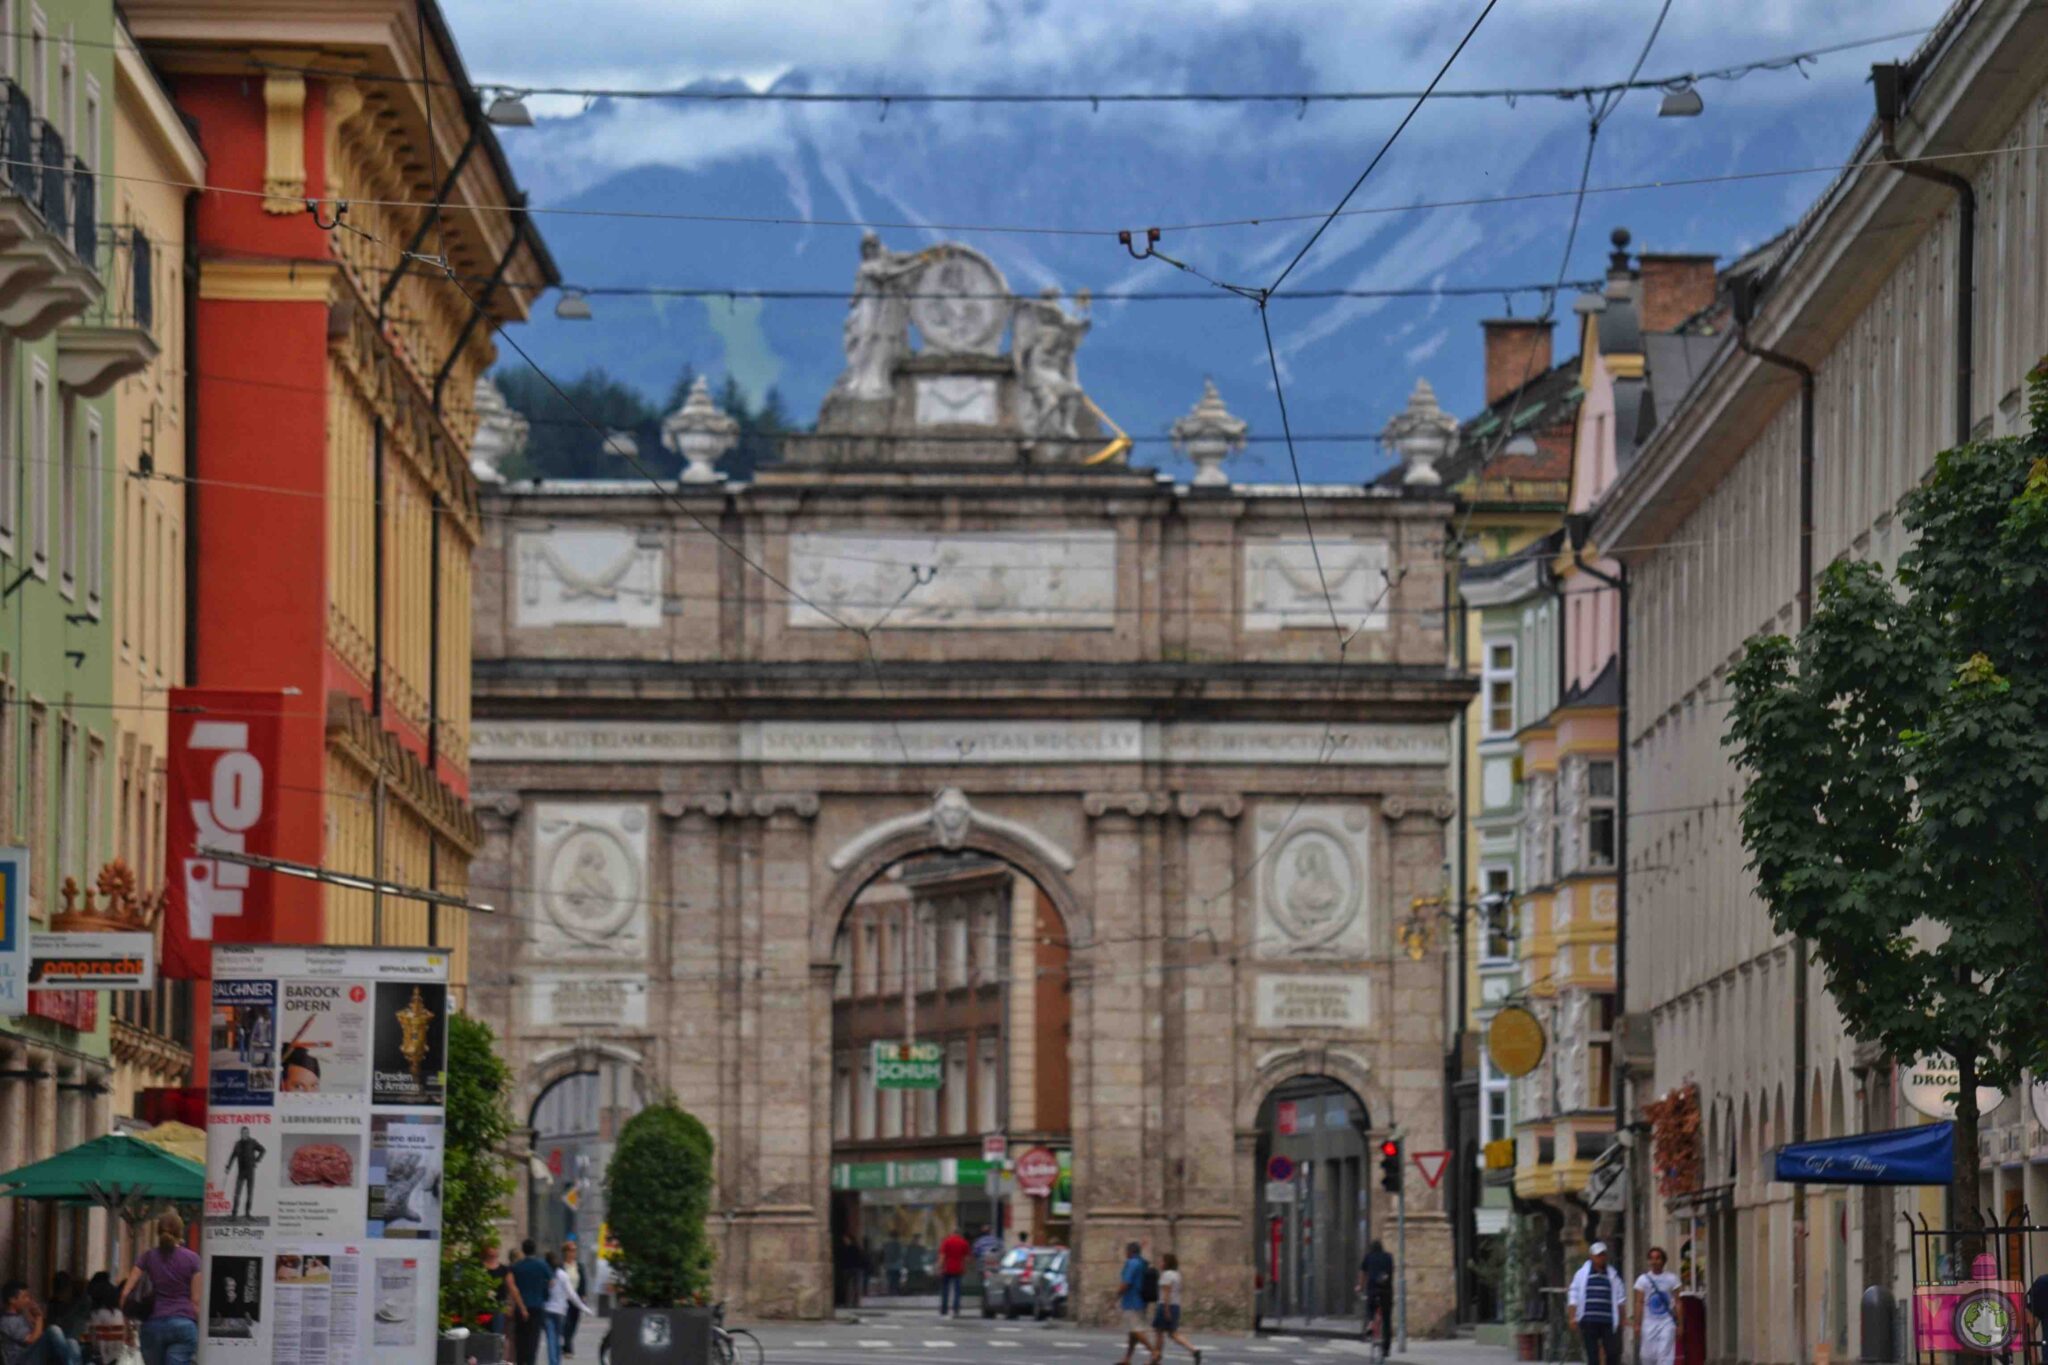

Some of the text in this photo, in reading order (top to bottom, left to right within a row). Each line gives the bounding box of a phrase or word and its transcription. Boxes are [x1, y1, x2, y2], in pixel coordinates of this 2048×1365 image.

[183, 720, 263, 940] Tirol
[285, 985, 341, 998] BAROCK
[284, 1000, 331, 1011] OPERN
[208, 1114, 272, 1125] ESETARITS
[281, 1115, 363, 1125] LEBENSMITTEL
